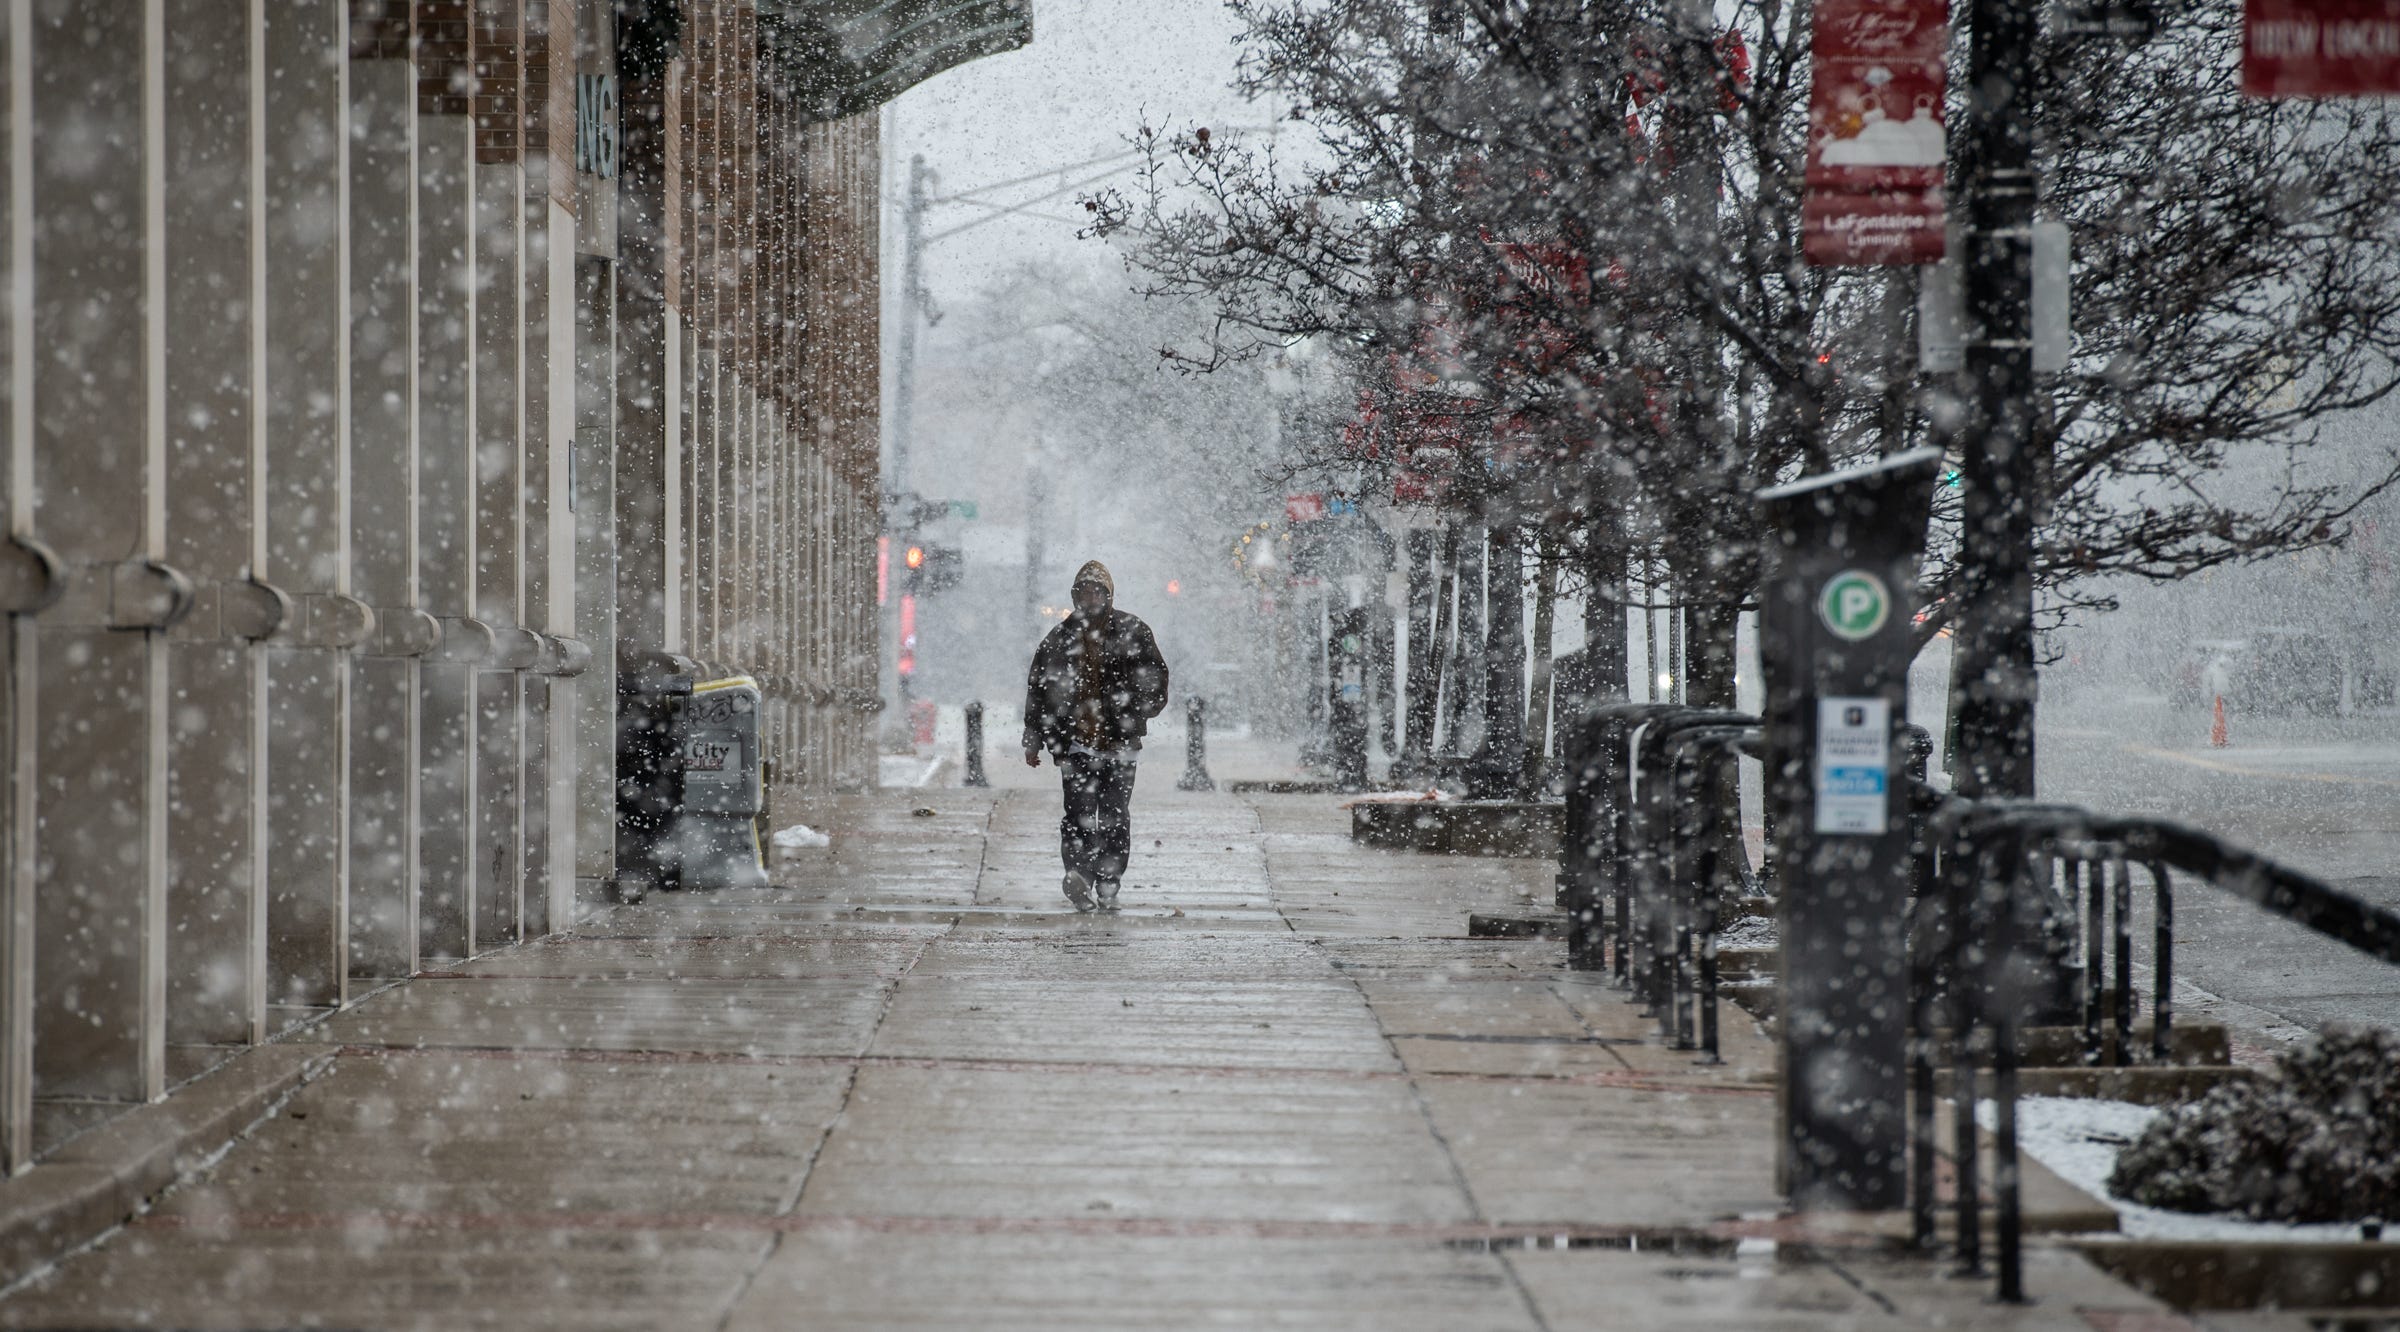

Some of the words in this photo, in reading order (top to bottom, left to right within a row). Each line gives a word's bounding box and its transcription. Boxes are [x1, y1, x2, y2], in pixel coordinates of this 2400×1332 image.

[1824, 213, 1925, 232] LaFontaine
[1841, 587, 1869, 623] P
[692, 743, 729, 764] City
